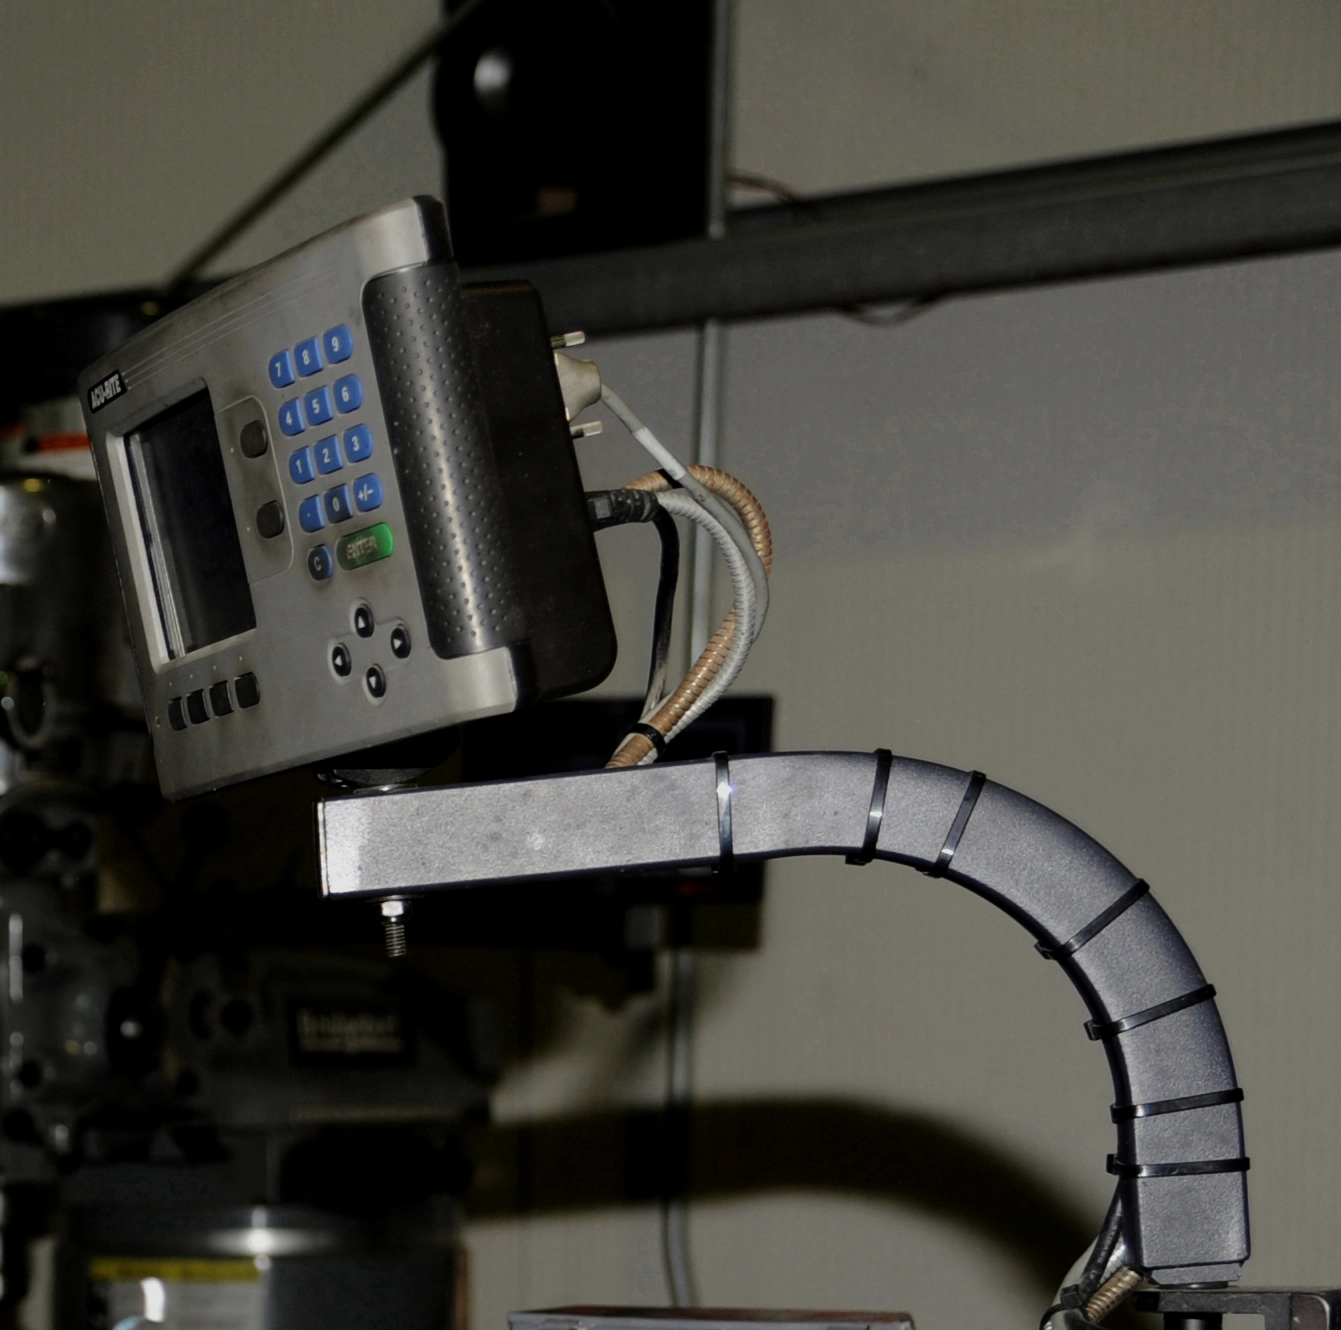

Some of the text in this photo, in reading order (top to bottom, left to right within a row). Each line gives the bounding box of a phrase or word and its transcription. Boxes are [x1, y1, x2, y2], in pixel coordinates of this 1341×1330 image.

[331, 336, 339, 352] 9
[302, 349, 310, 365] 8
[275, 362, 281, 377] 7
[90, 373, 122, 410] ACU-RITE
[341, 386, 349, 402] 6
[312, 398, 320, 414] 5
[285, 410, 293, 425] 4
[351, 435, 360, 452] 3
[322, 447, 331, 464] 2
[295, 459, 302, 474] 1
[332, 496, 340, 512] 0
[345, 535, 378, 560] ENTER
[313, 556, 322, 571] C
